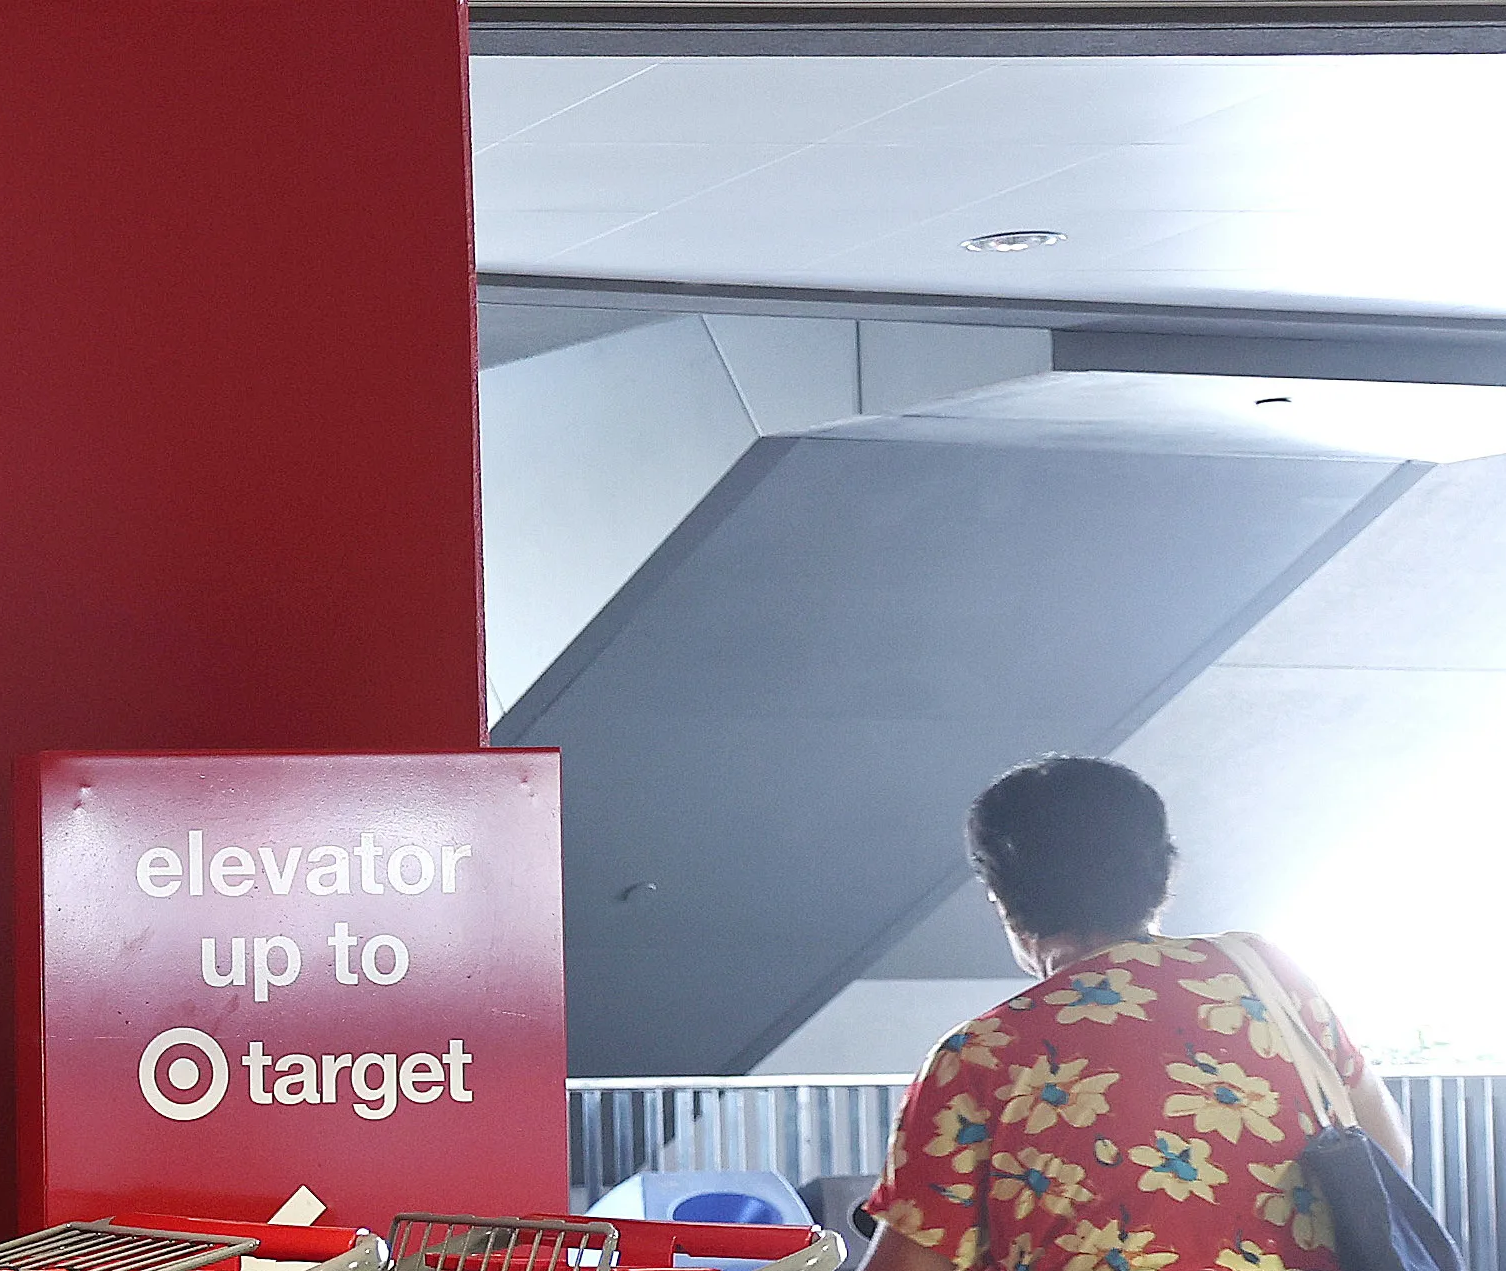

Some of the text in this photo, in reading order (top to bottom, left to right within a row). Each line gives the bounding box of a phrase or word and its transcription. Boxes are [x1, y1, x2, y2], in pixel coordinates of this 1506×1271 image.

[136, 829, 473, 898] elevator
[200, 921, 410, 1002] up to
[241, 1039, 474, 1120] target
